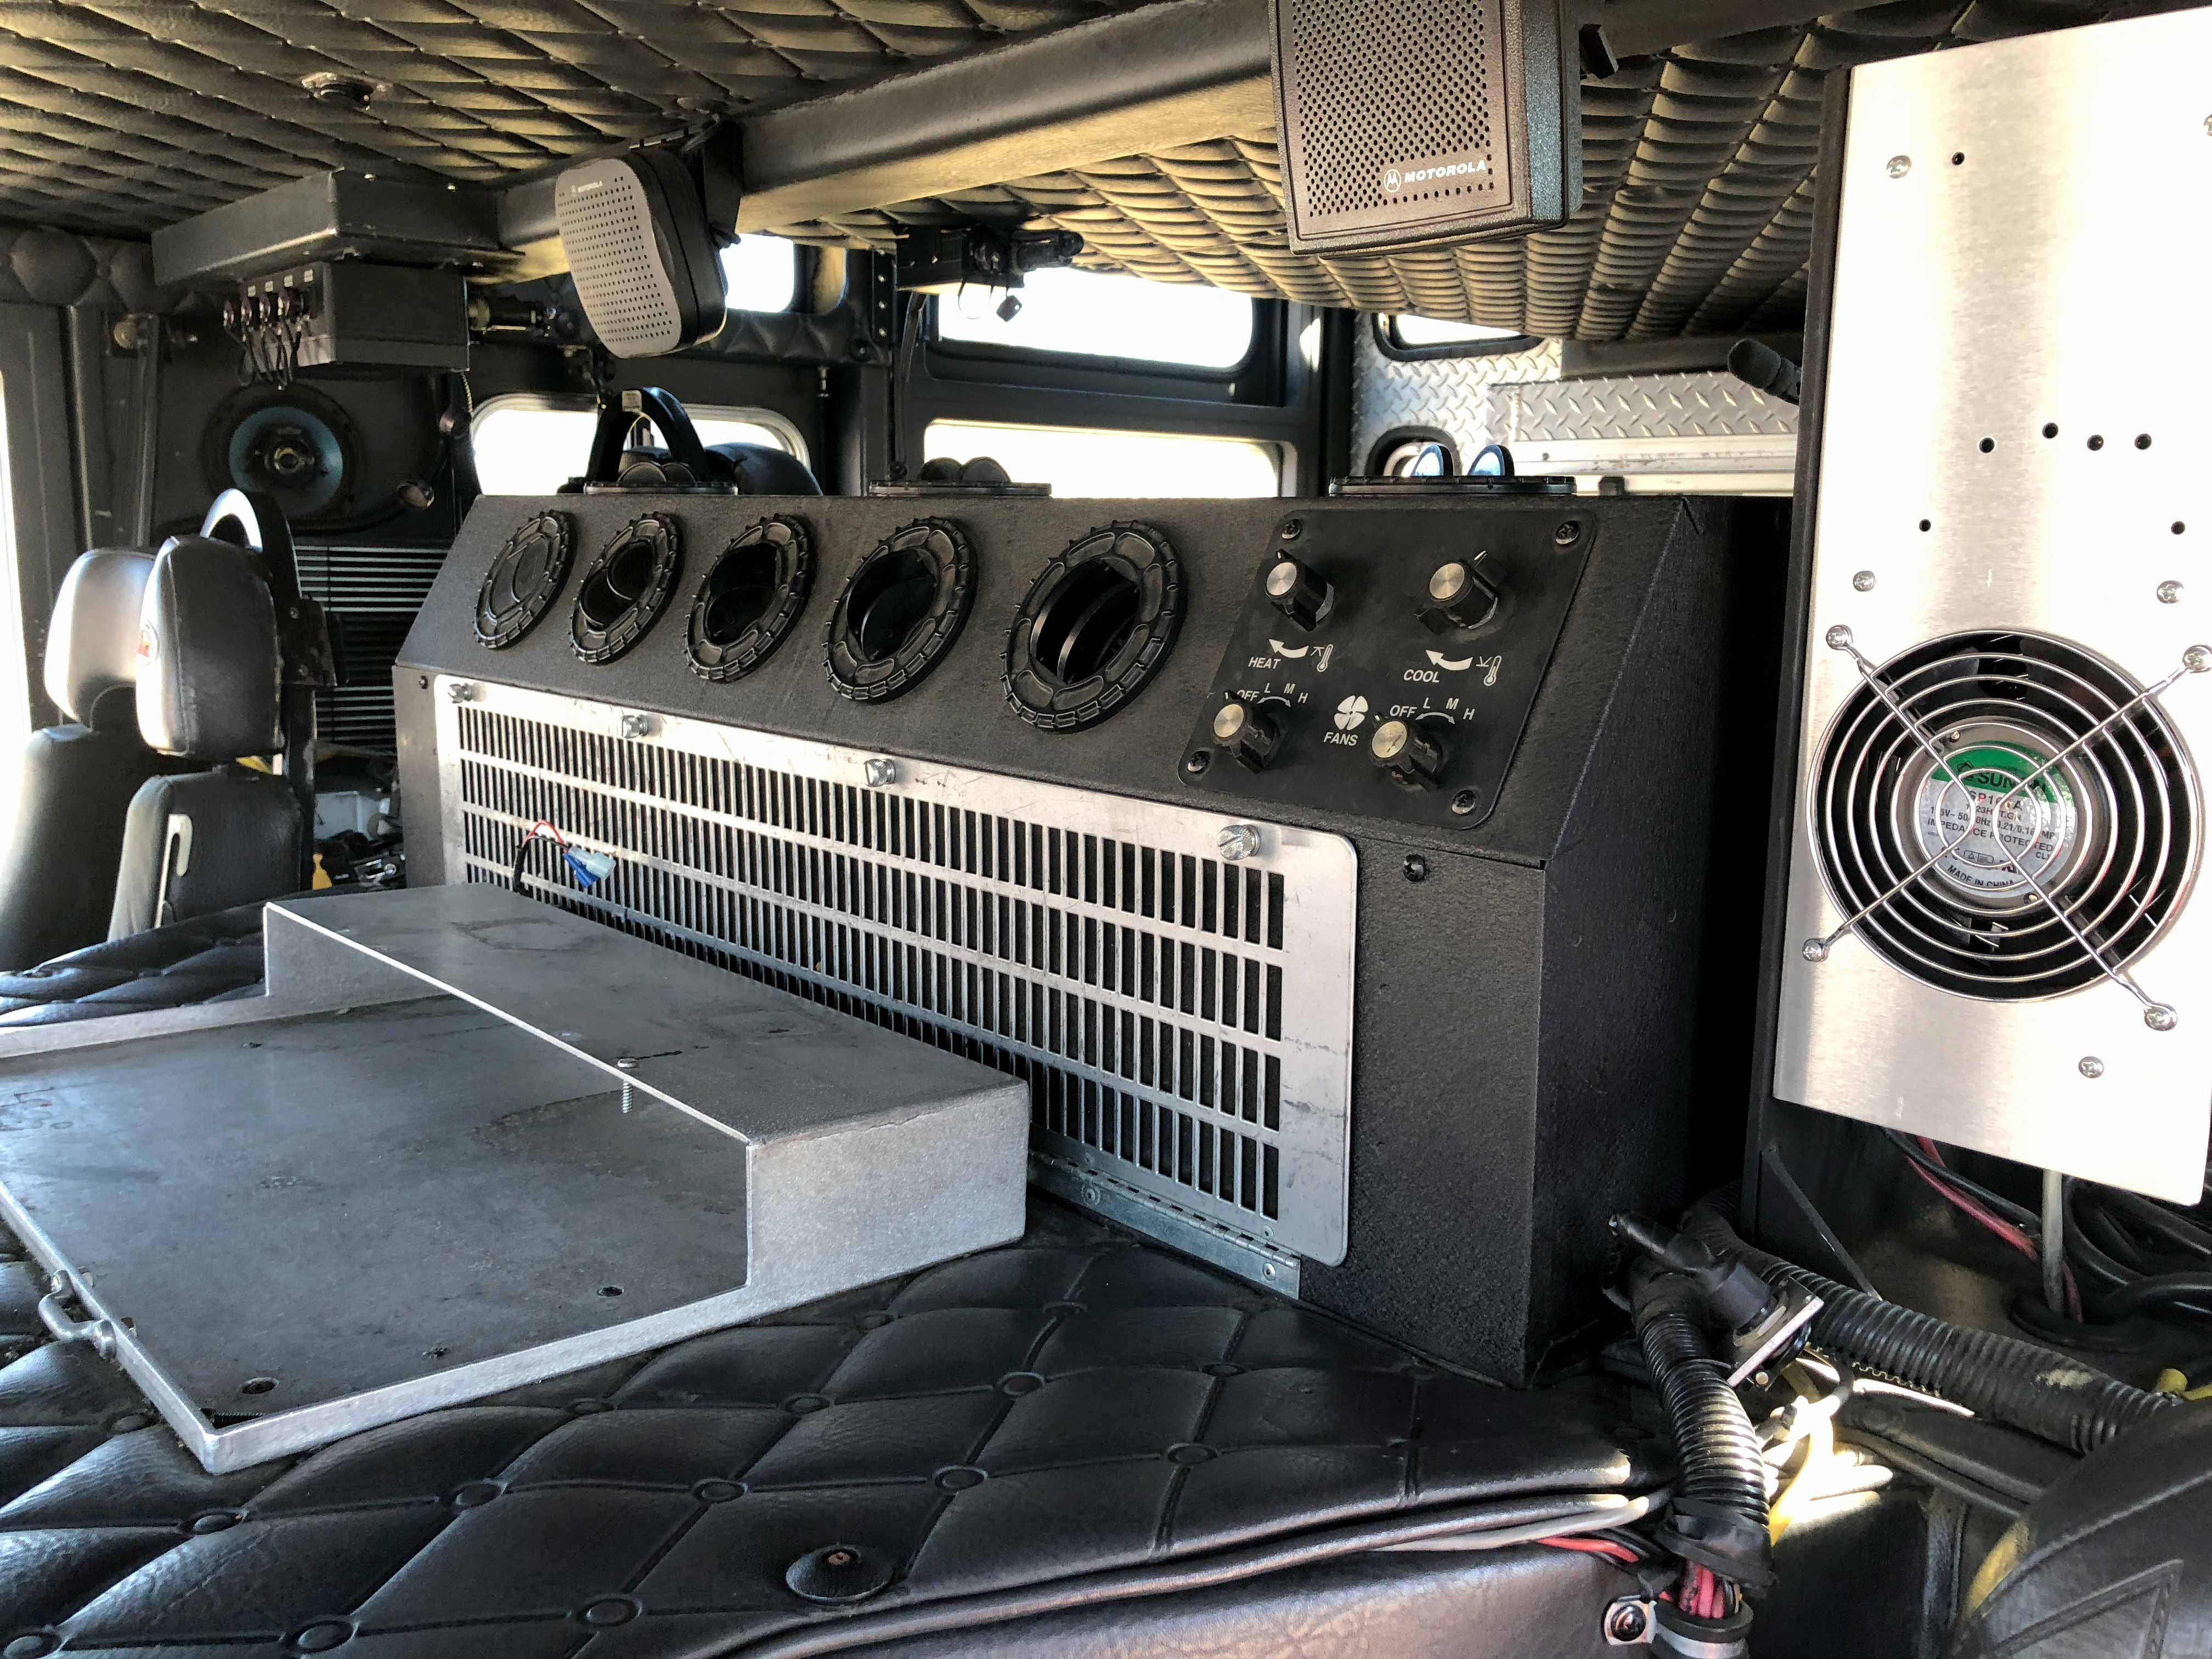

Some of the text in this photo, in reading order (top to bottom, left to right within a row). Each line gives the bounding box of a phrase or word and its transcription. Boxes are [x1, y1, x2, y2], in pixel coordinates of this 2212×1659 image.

[1404, 160, 1486, 183] MOTOROLA
[1248, 657, 1281, 669] HEAT
[1403, 669, 1440, 683] COOL
[1237, 682, 1308, 703] OFF L M H
[1390, 697, 1475, 720] OFF L M H
[1323, 731, 1358, 746] FANS
[1927, 817, 1987, 837] IPEDACE
[1958, 812, 1991, 826] 50/0Hz
[1948, 865, 1973, 882] MADE
